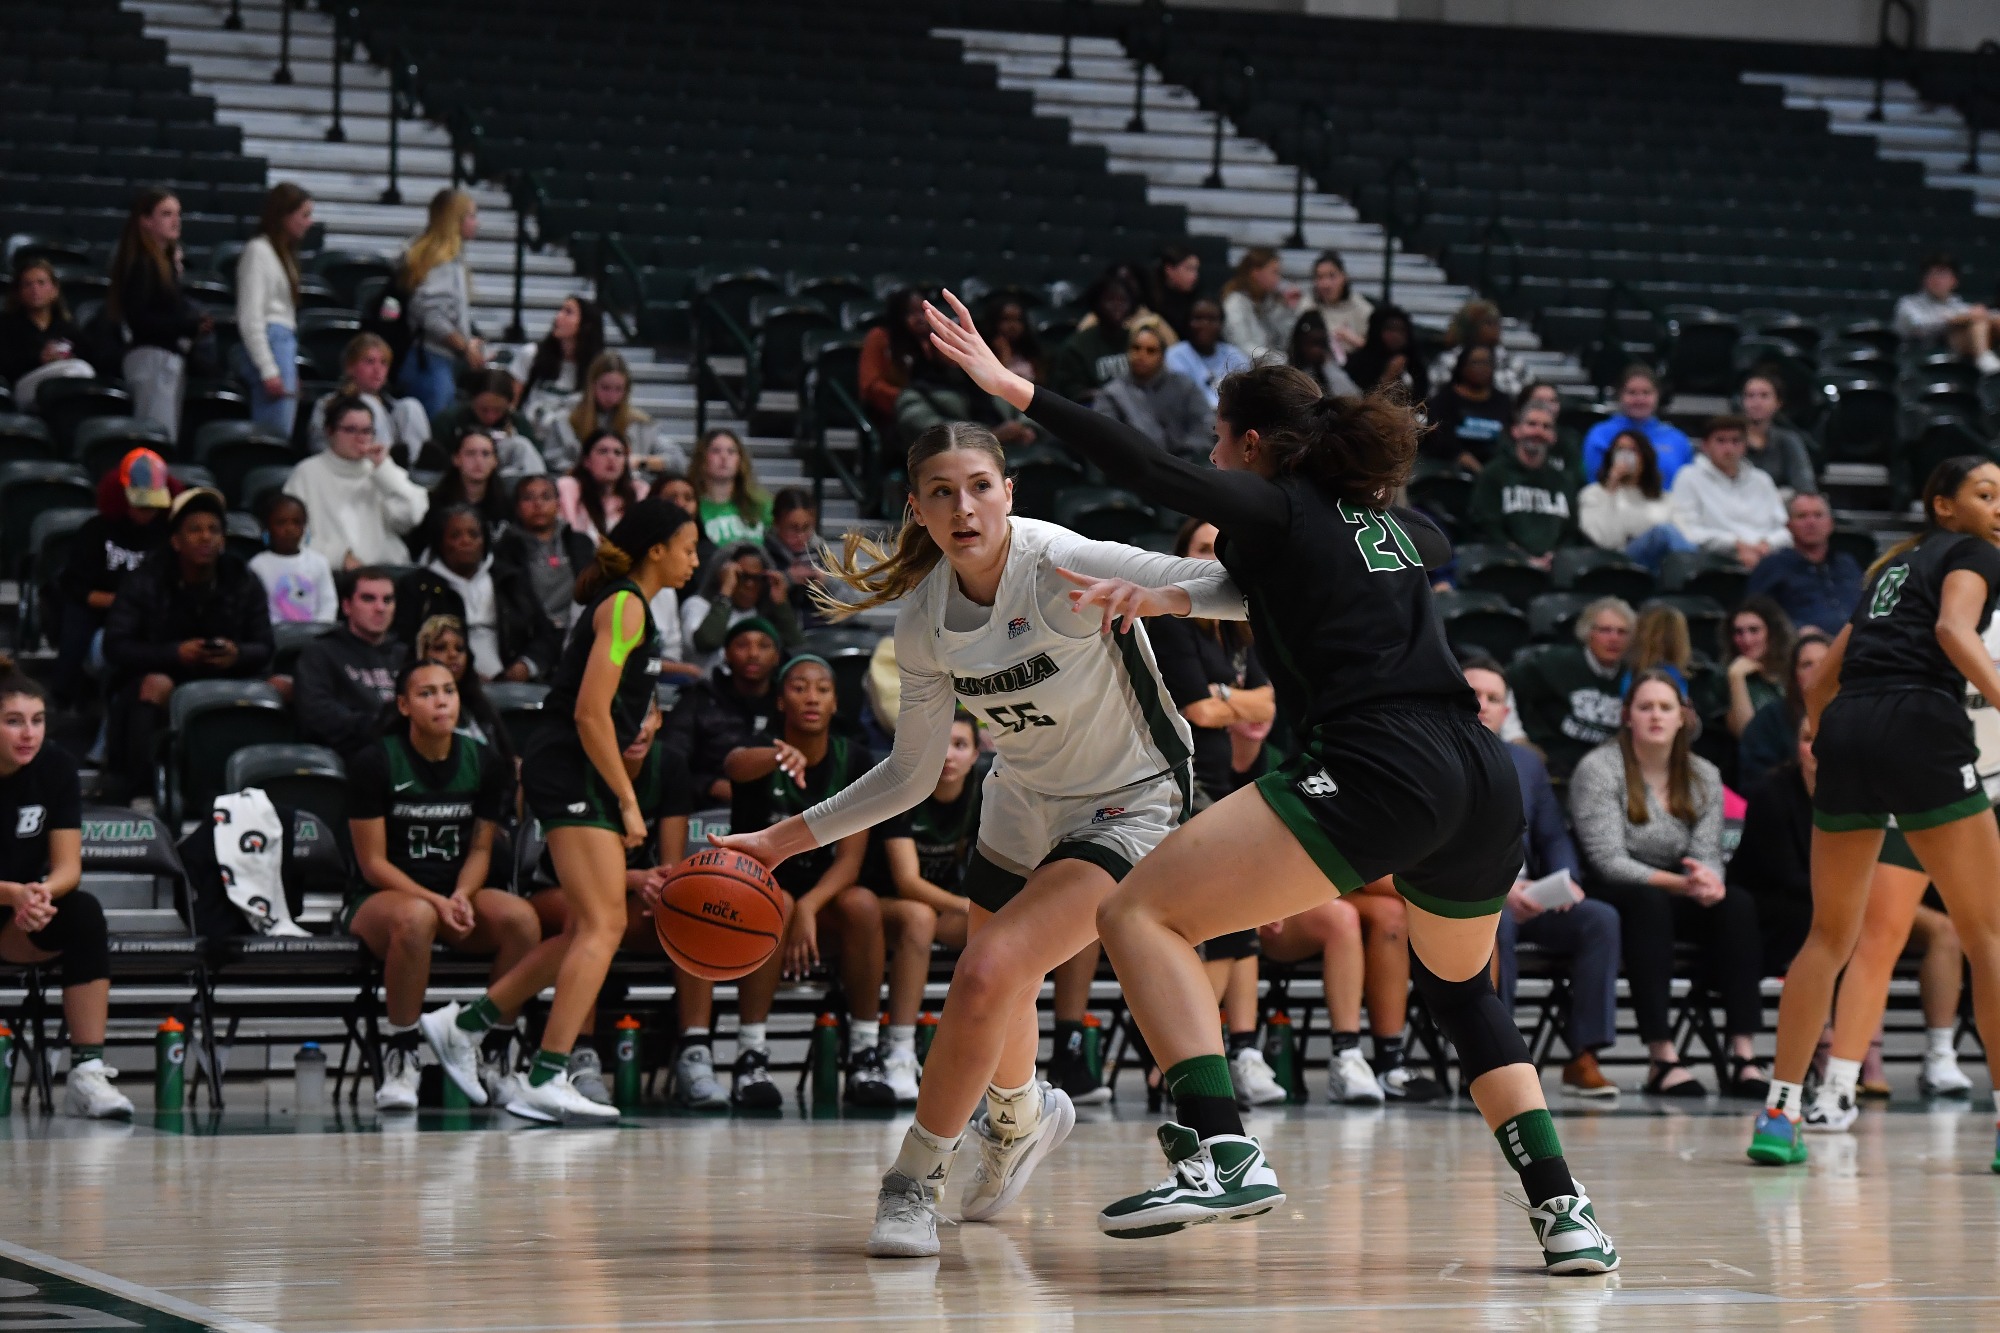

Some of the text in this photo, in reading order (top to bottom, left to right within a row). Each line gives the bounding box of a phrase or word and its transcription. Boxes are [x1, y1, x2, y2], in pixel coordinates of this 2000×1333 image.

[1502, 485, 1570, 518] LOYOLA
[1869, 563, 1910, 619] 0
[16, 805, 46, 838] B
[81, 845, 148, 857] EYHOUNDS
[408, 825, 460, 861] 14
